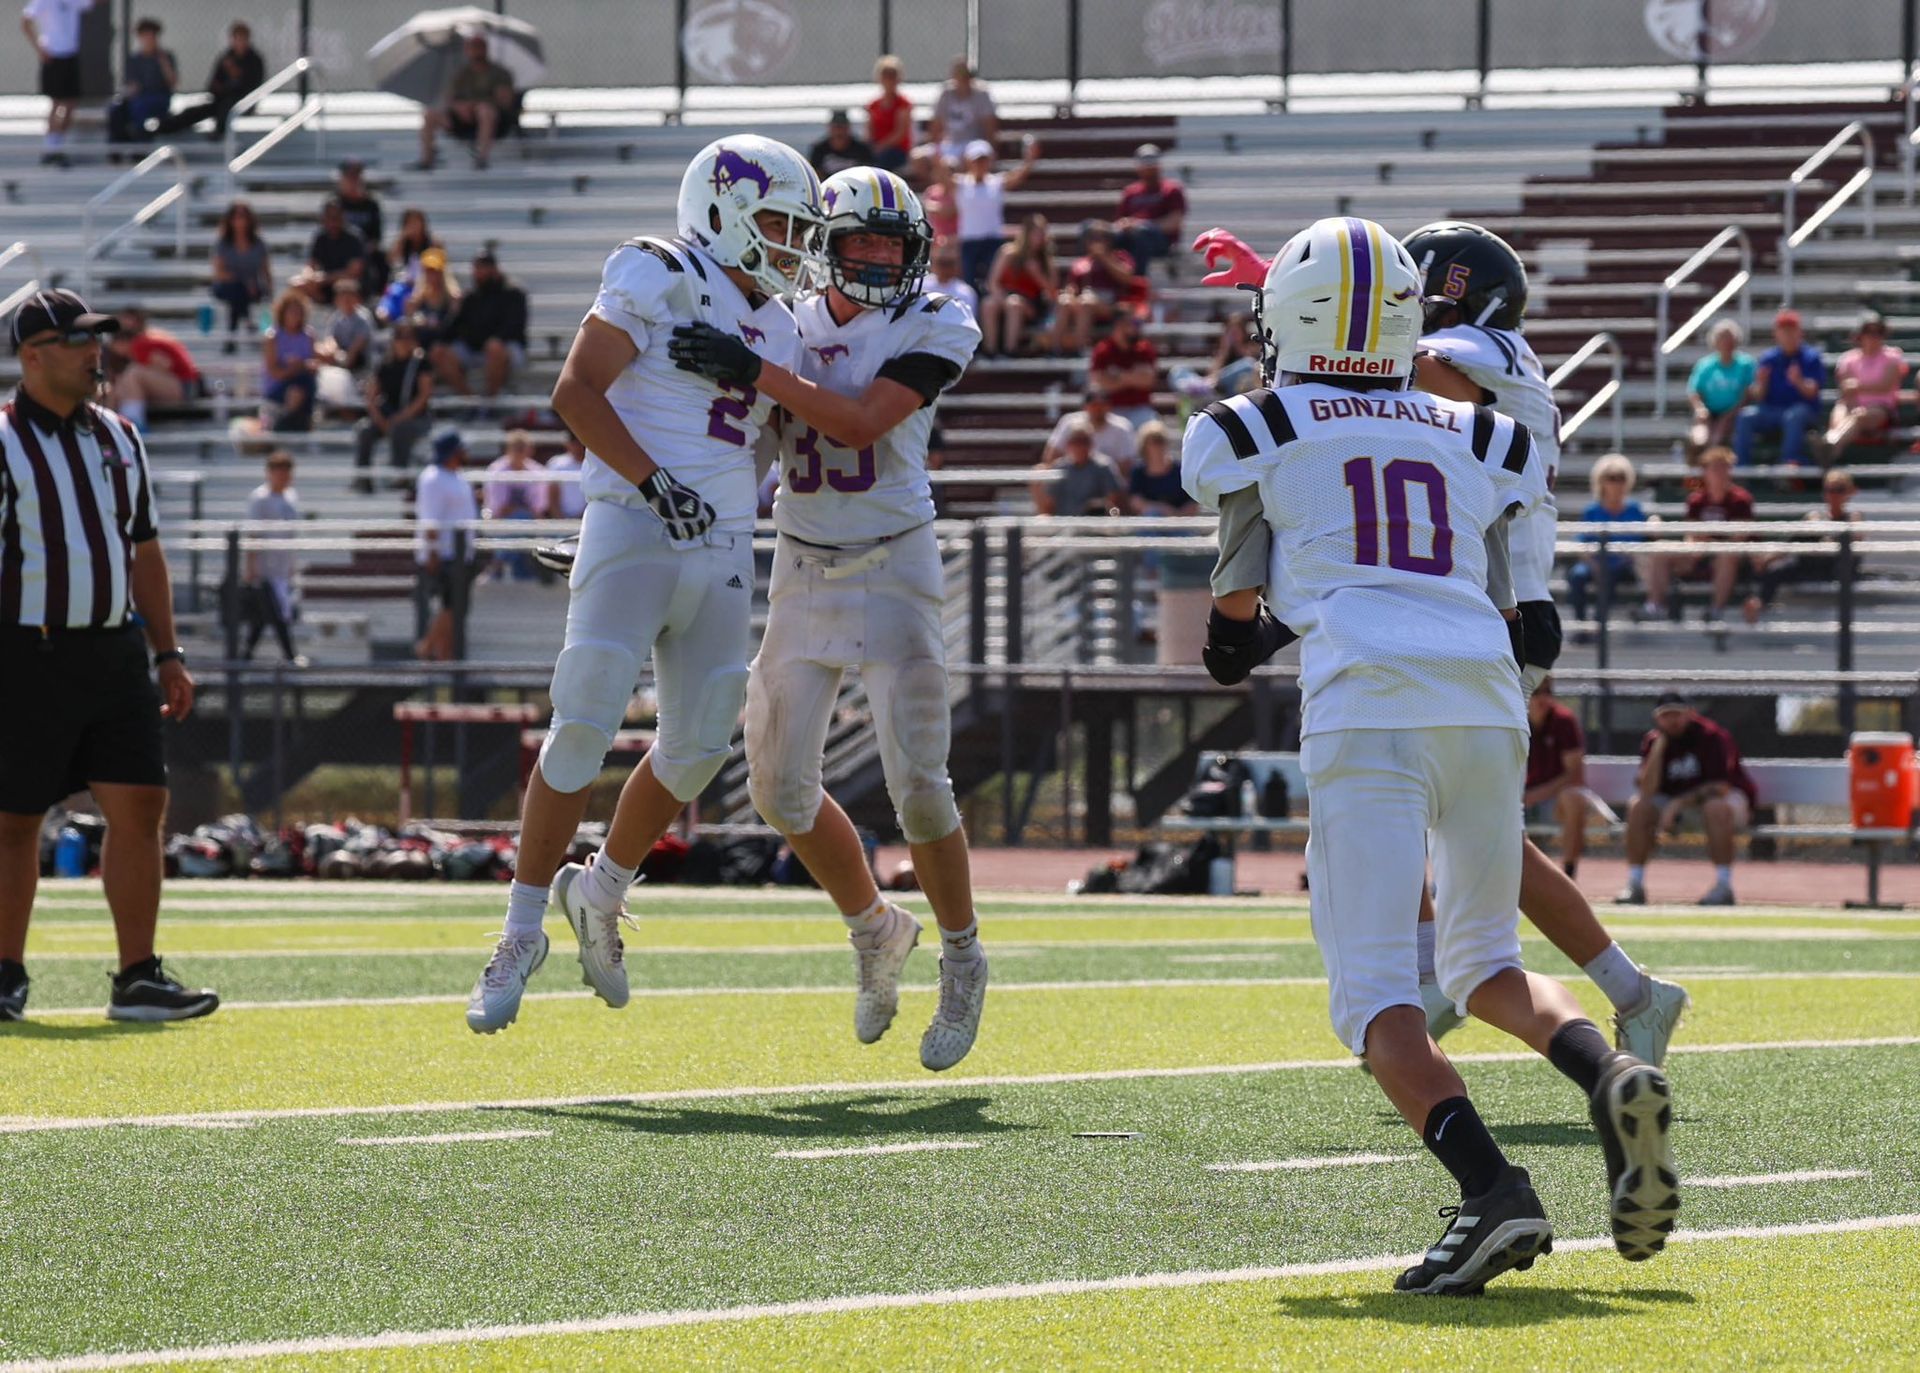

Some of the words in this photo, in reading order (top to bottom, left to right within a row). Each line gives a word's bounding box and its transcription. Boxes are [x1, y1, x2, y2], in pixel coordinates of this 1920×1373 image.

[1443, 263, 1471, 300] 5
[1309, 354, 1396, 376] Riddell
[707, 377, 758, 447] 2
[1309, 396, 1462, 434] GONZALEZ
[1343, 456, 1454, 577] 10
